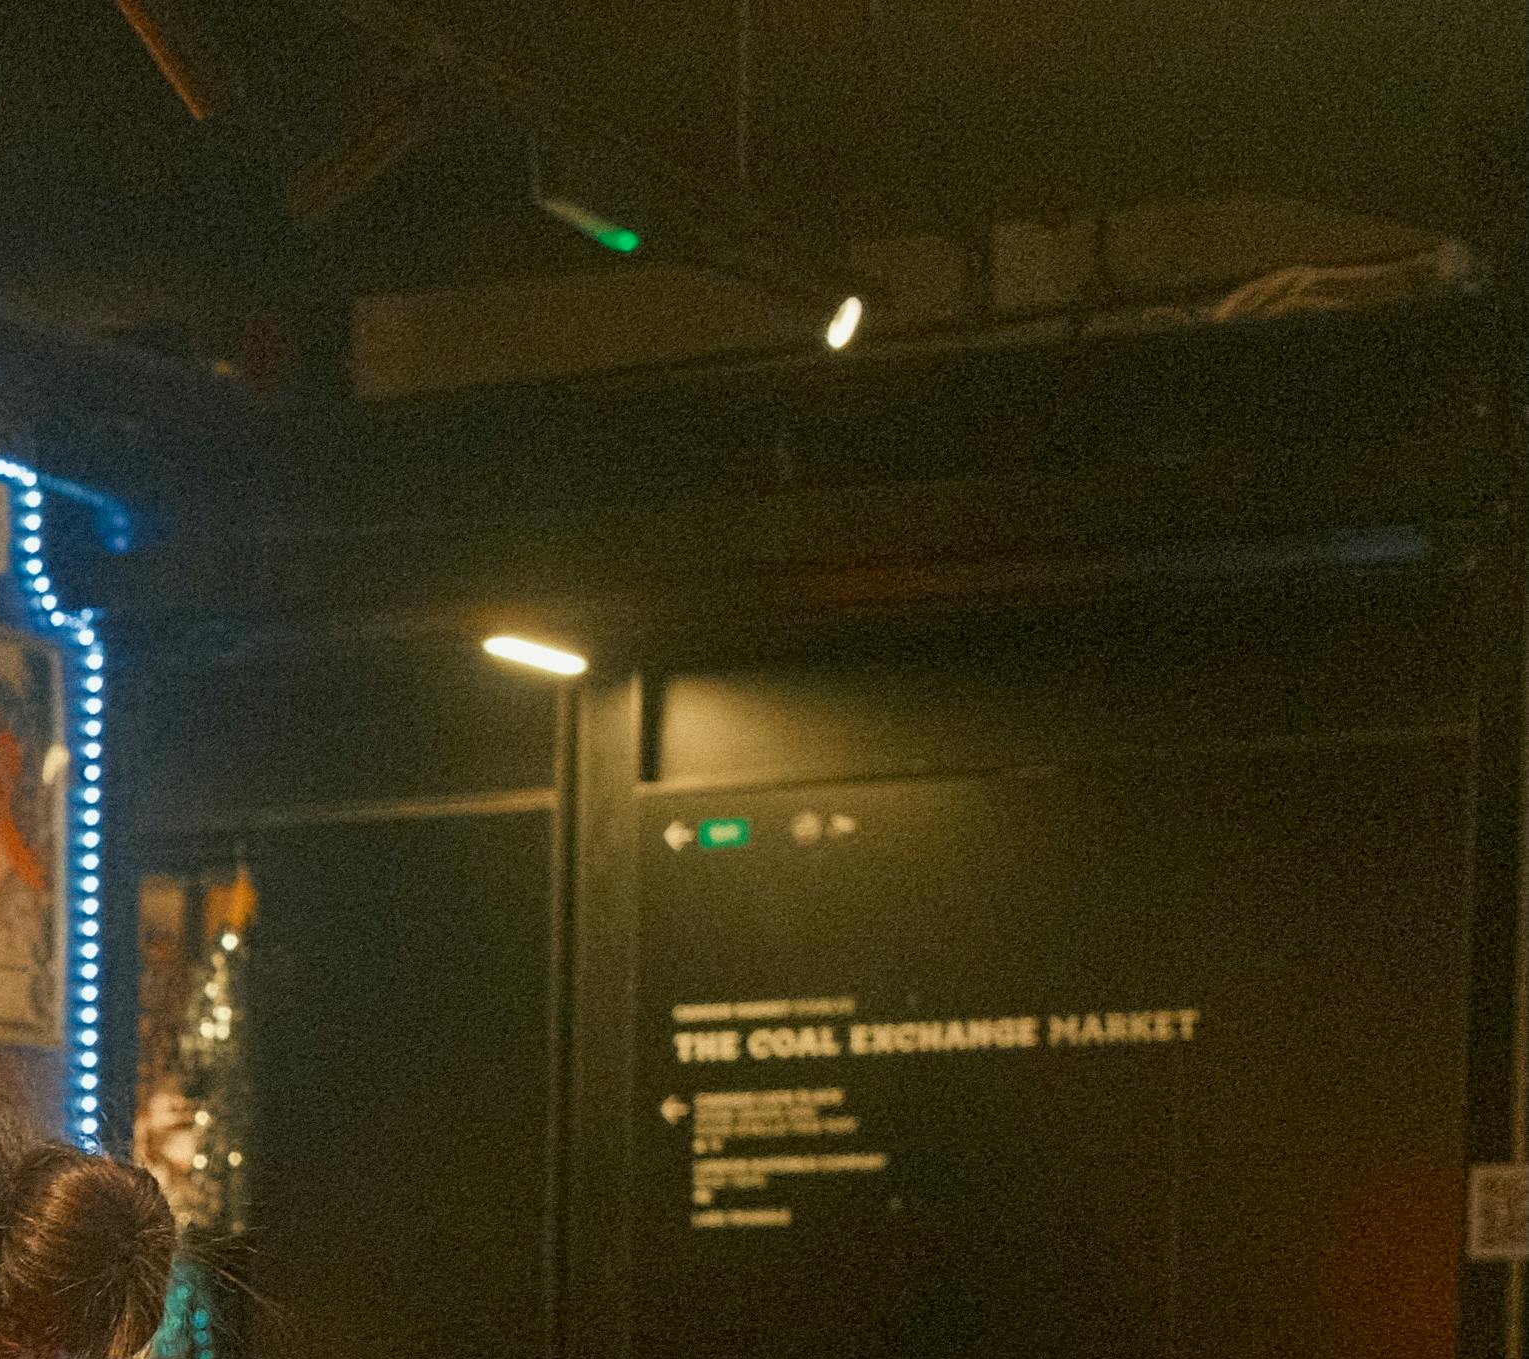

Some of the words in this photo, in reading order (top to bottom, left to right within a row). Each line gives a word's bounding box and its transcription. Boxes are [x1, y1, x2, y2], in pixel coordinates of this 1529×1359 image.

[674, 1030, 739, 1064] THE
[747, 1025, 840, 1060] COAL
[850, 1017, 1038, 1056] EXCHANGE
[1049, 1009, 1202, 1048] MARKET
